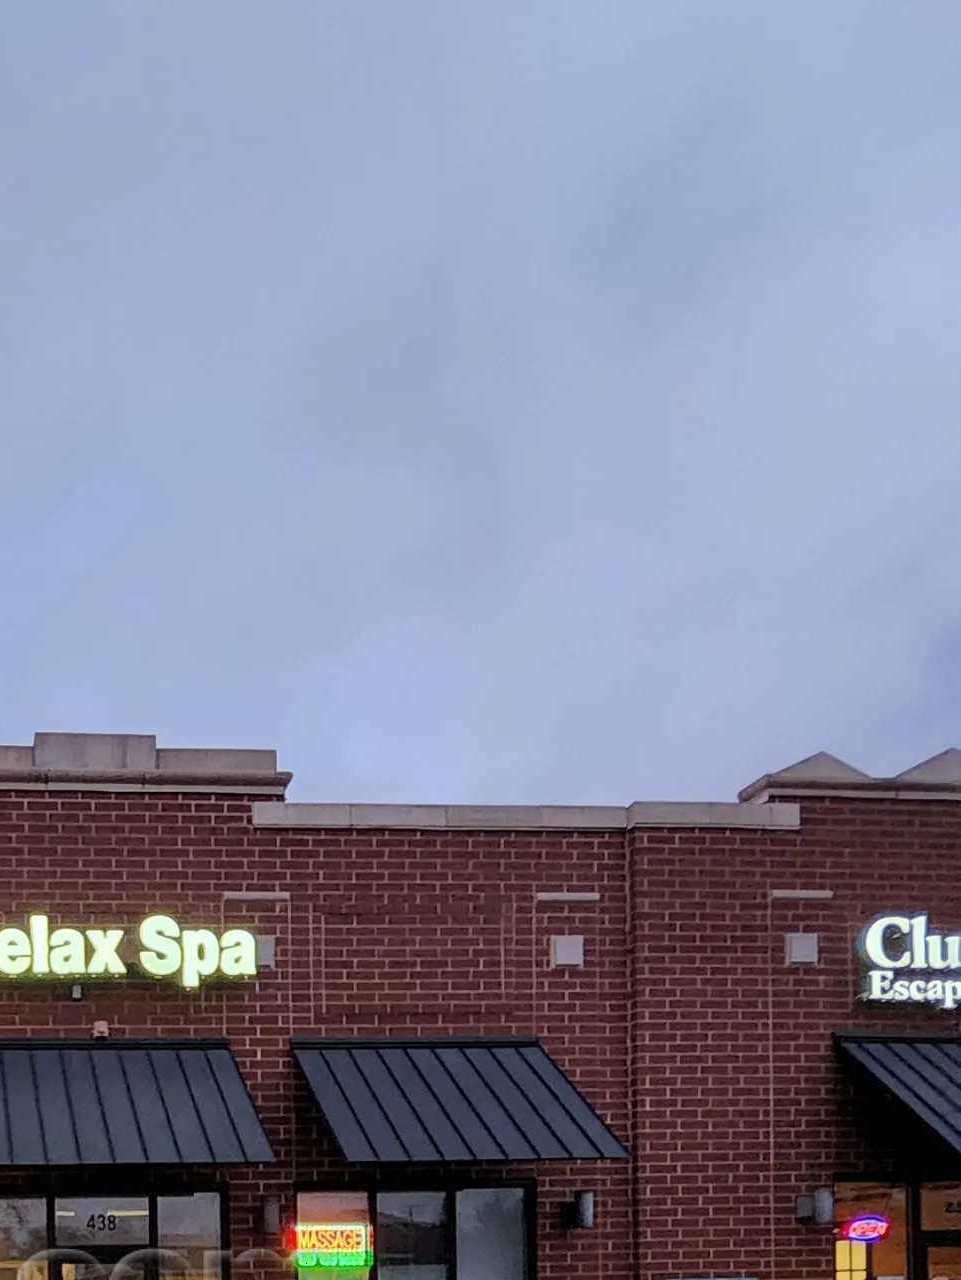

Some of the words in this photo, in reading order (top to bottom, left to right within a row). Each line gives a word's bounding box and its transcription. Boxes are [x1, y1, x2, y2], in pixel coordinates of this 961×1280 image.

[138, 914, 257, 988] Spa
[868, 970, 961, 1010] Escap
[86, 1214, 117, 1231] 438
[848, 1222, 888, 1236] OPEN
[296, 1229, 363, 1249] MASSAGE
